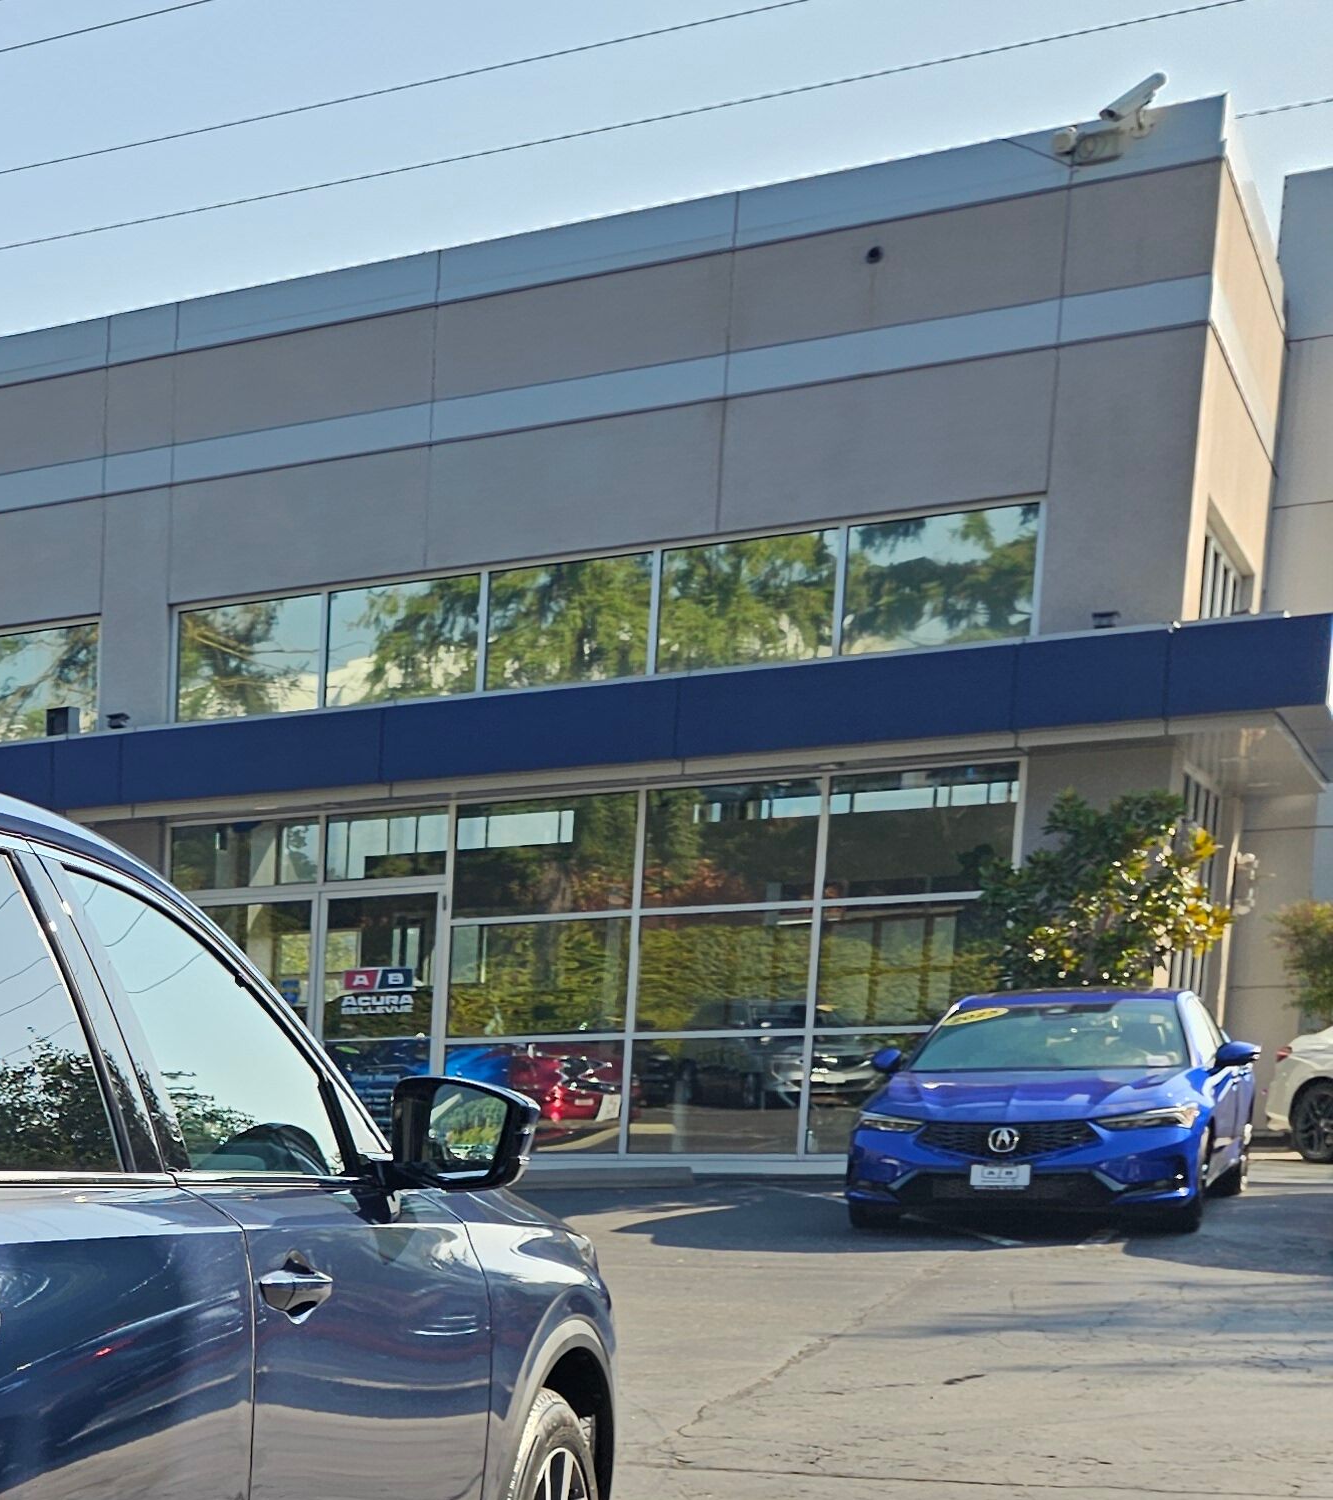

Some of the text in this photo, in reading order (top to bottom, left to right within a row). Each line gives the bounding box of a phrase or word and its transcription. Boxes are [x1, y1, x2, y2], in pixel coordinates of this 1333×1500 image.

[352, 972, 405, 986] A B
[341, 994, 414, 1007] ACURA
